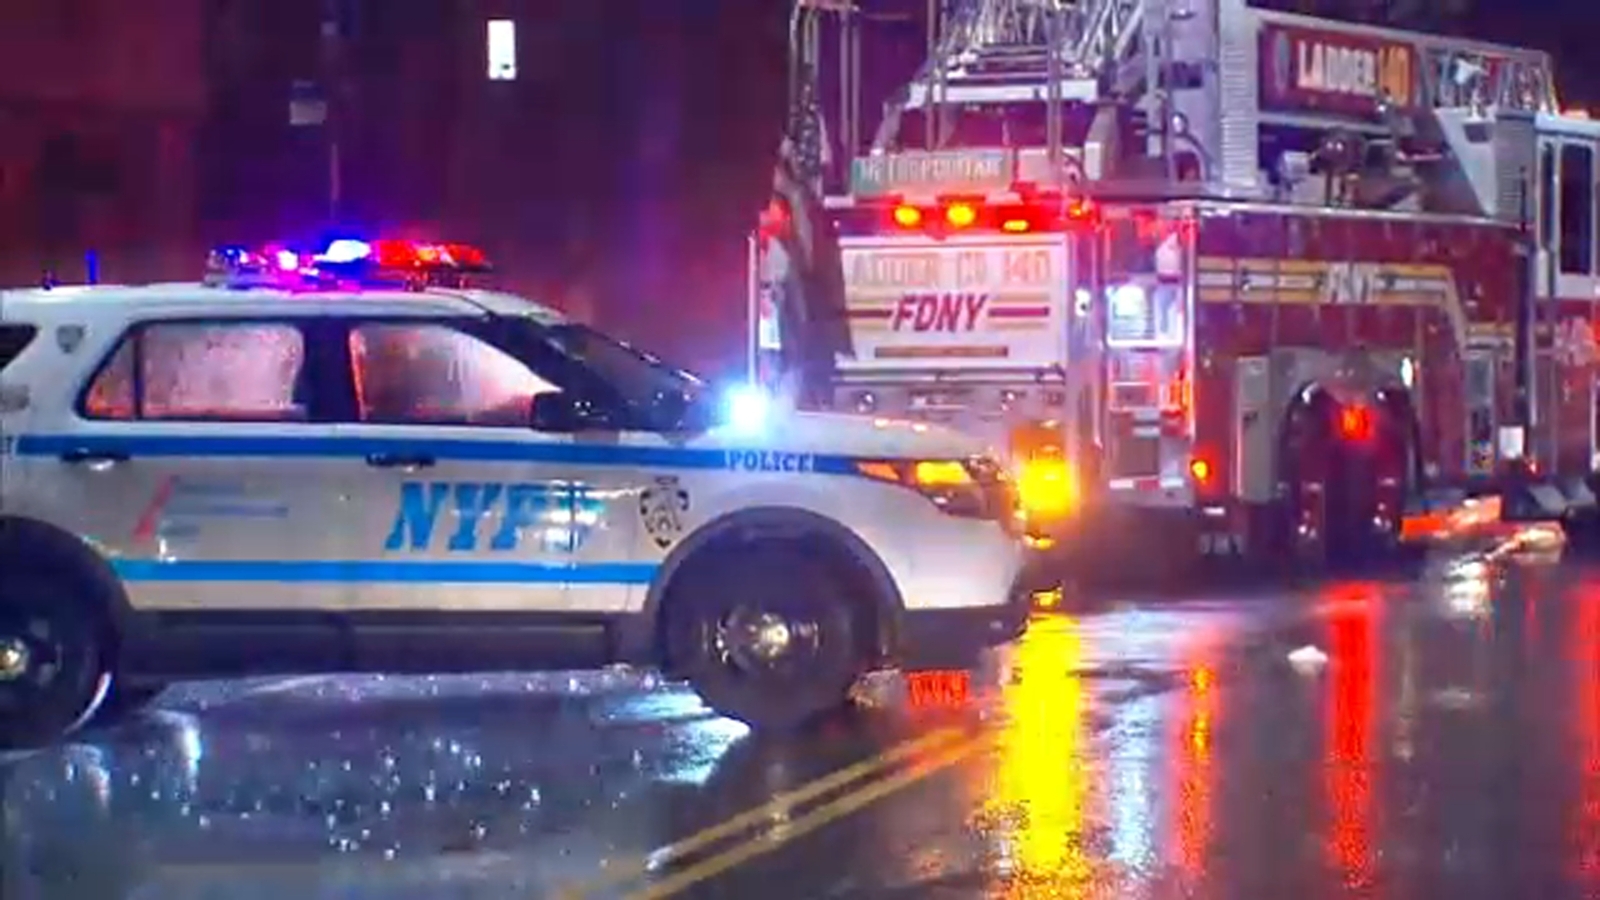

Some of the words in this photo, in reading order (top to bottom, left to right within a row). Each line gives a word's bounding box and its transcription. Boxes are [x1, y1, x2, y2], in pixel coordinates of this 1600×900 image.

[1297, 40, 1376, 95] LADDER
[850, 250, 941, 287] ADDER
[893, 293, 988, 332] FDNY
[727, 450, 813, 472] POLICE
